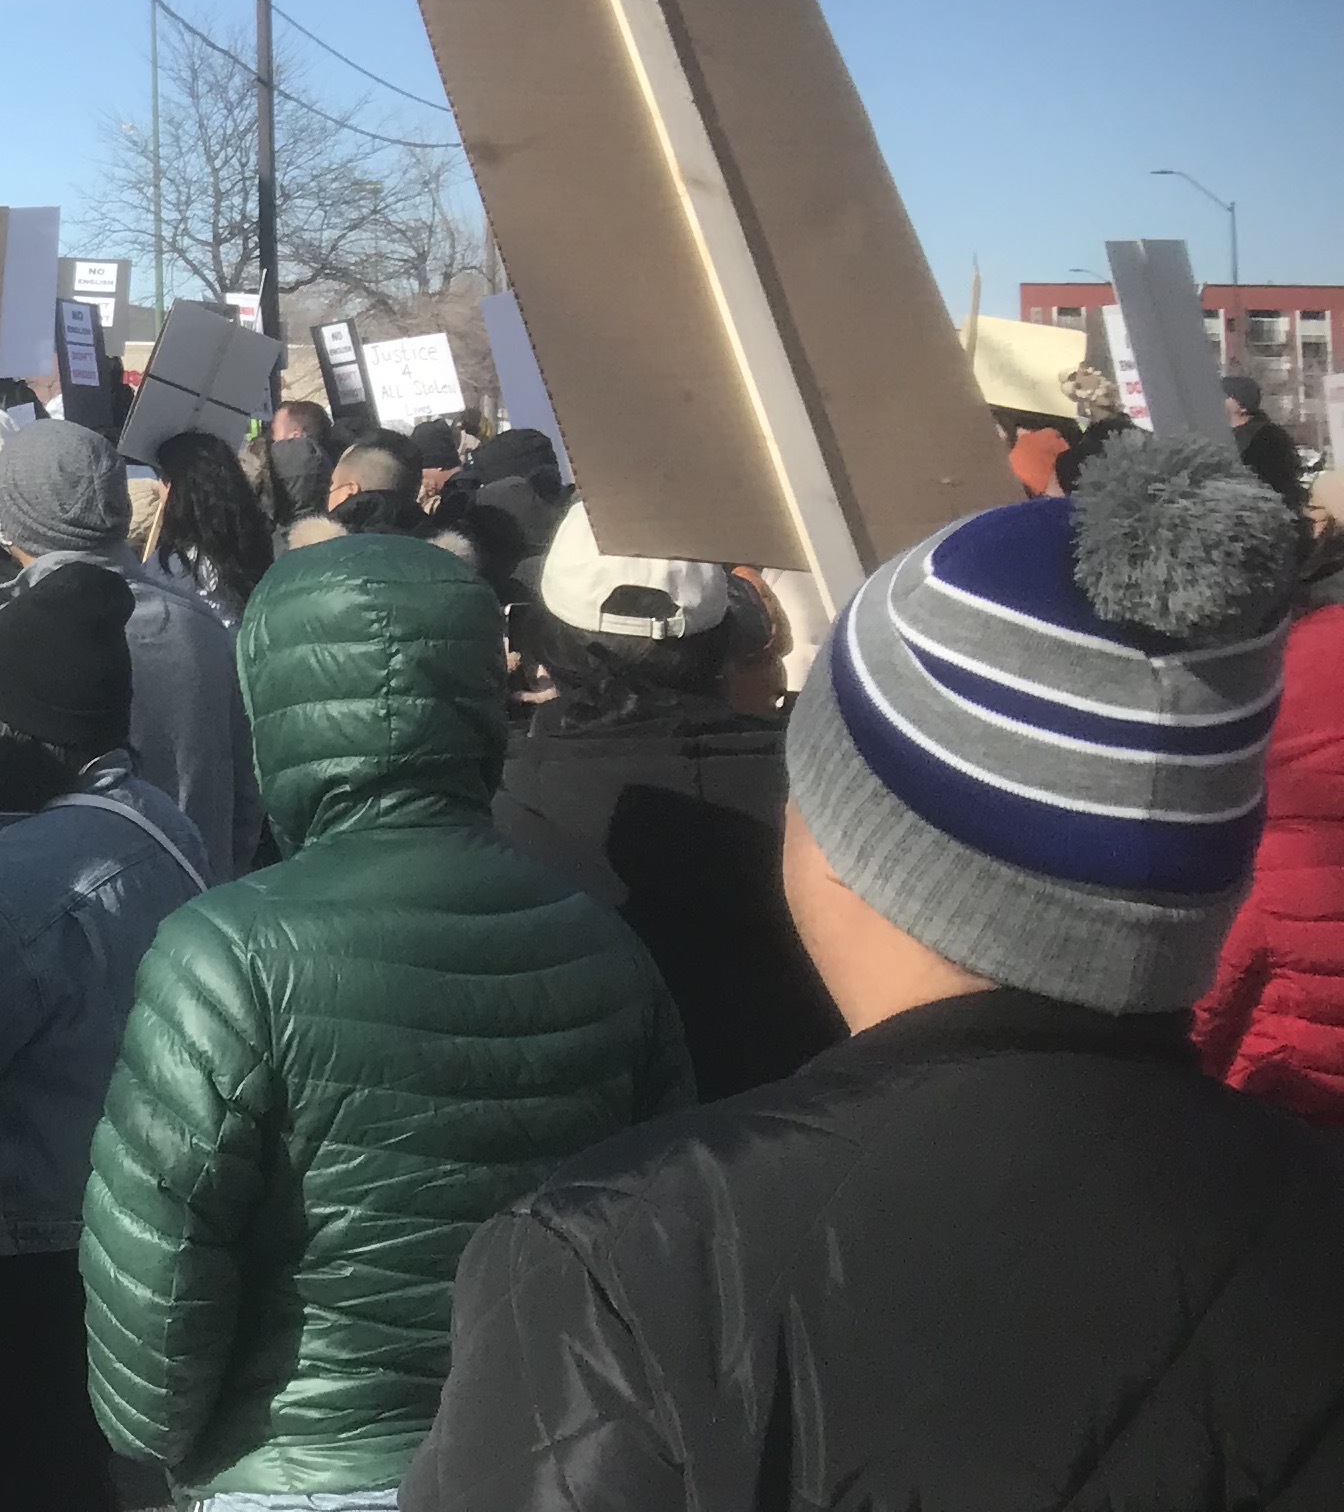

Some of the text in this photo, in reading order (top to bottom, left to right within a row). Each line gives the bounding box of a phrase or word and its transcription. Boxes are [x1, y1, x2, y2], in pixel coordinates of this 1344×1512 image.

[88, 268, 105, 276] NO
[77, 278, 114, 286] ENGLISH
[370, 340, 440, 366] Justice
[401, 363, 414, 380] 4
